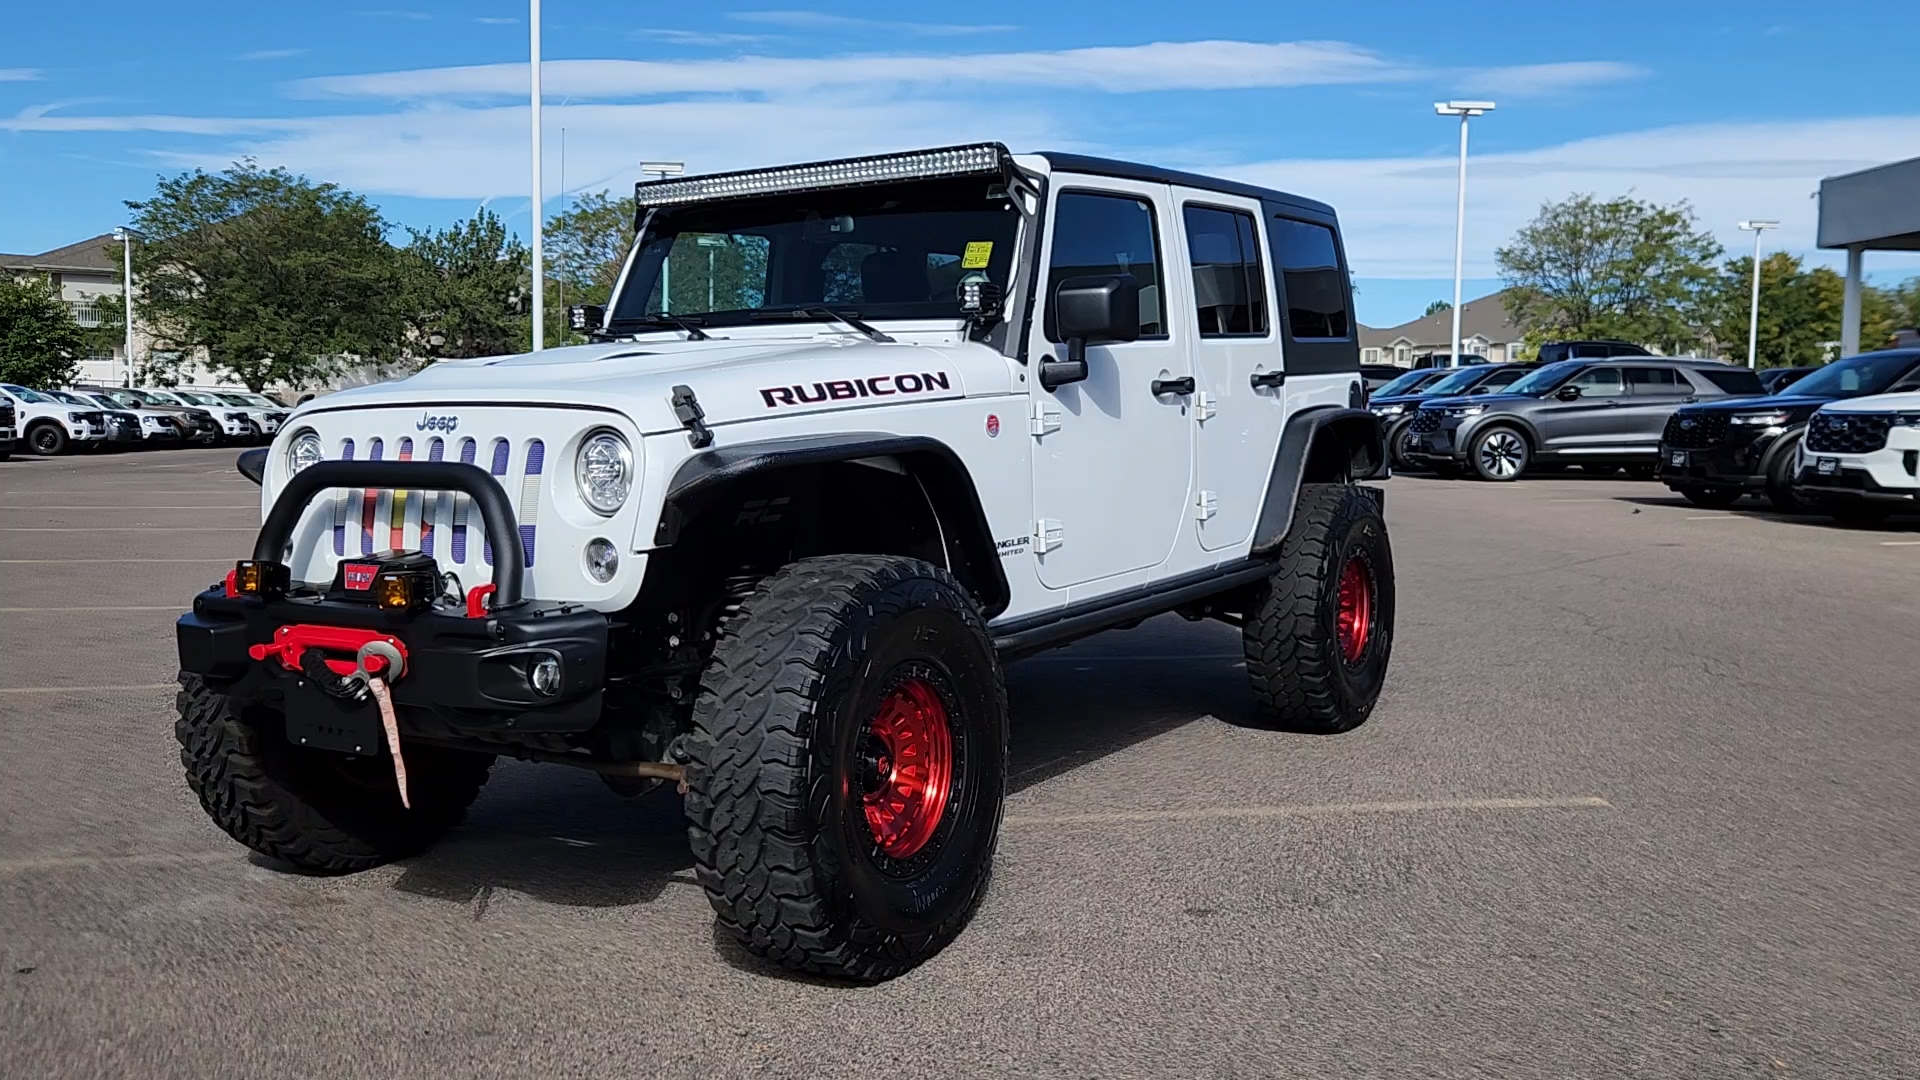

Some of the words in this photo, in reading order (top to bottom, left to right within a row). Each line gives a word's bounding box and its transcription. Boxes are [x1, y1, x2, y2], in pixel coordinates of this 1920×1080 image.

[759, 372, 950, 408] RUBICON
[416, 411, 459, 434] Jeep
[997, 536, 1030, 549] NGLER
